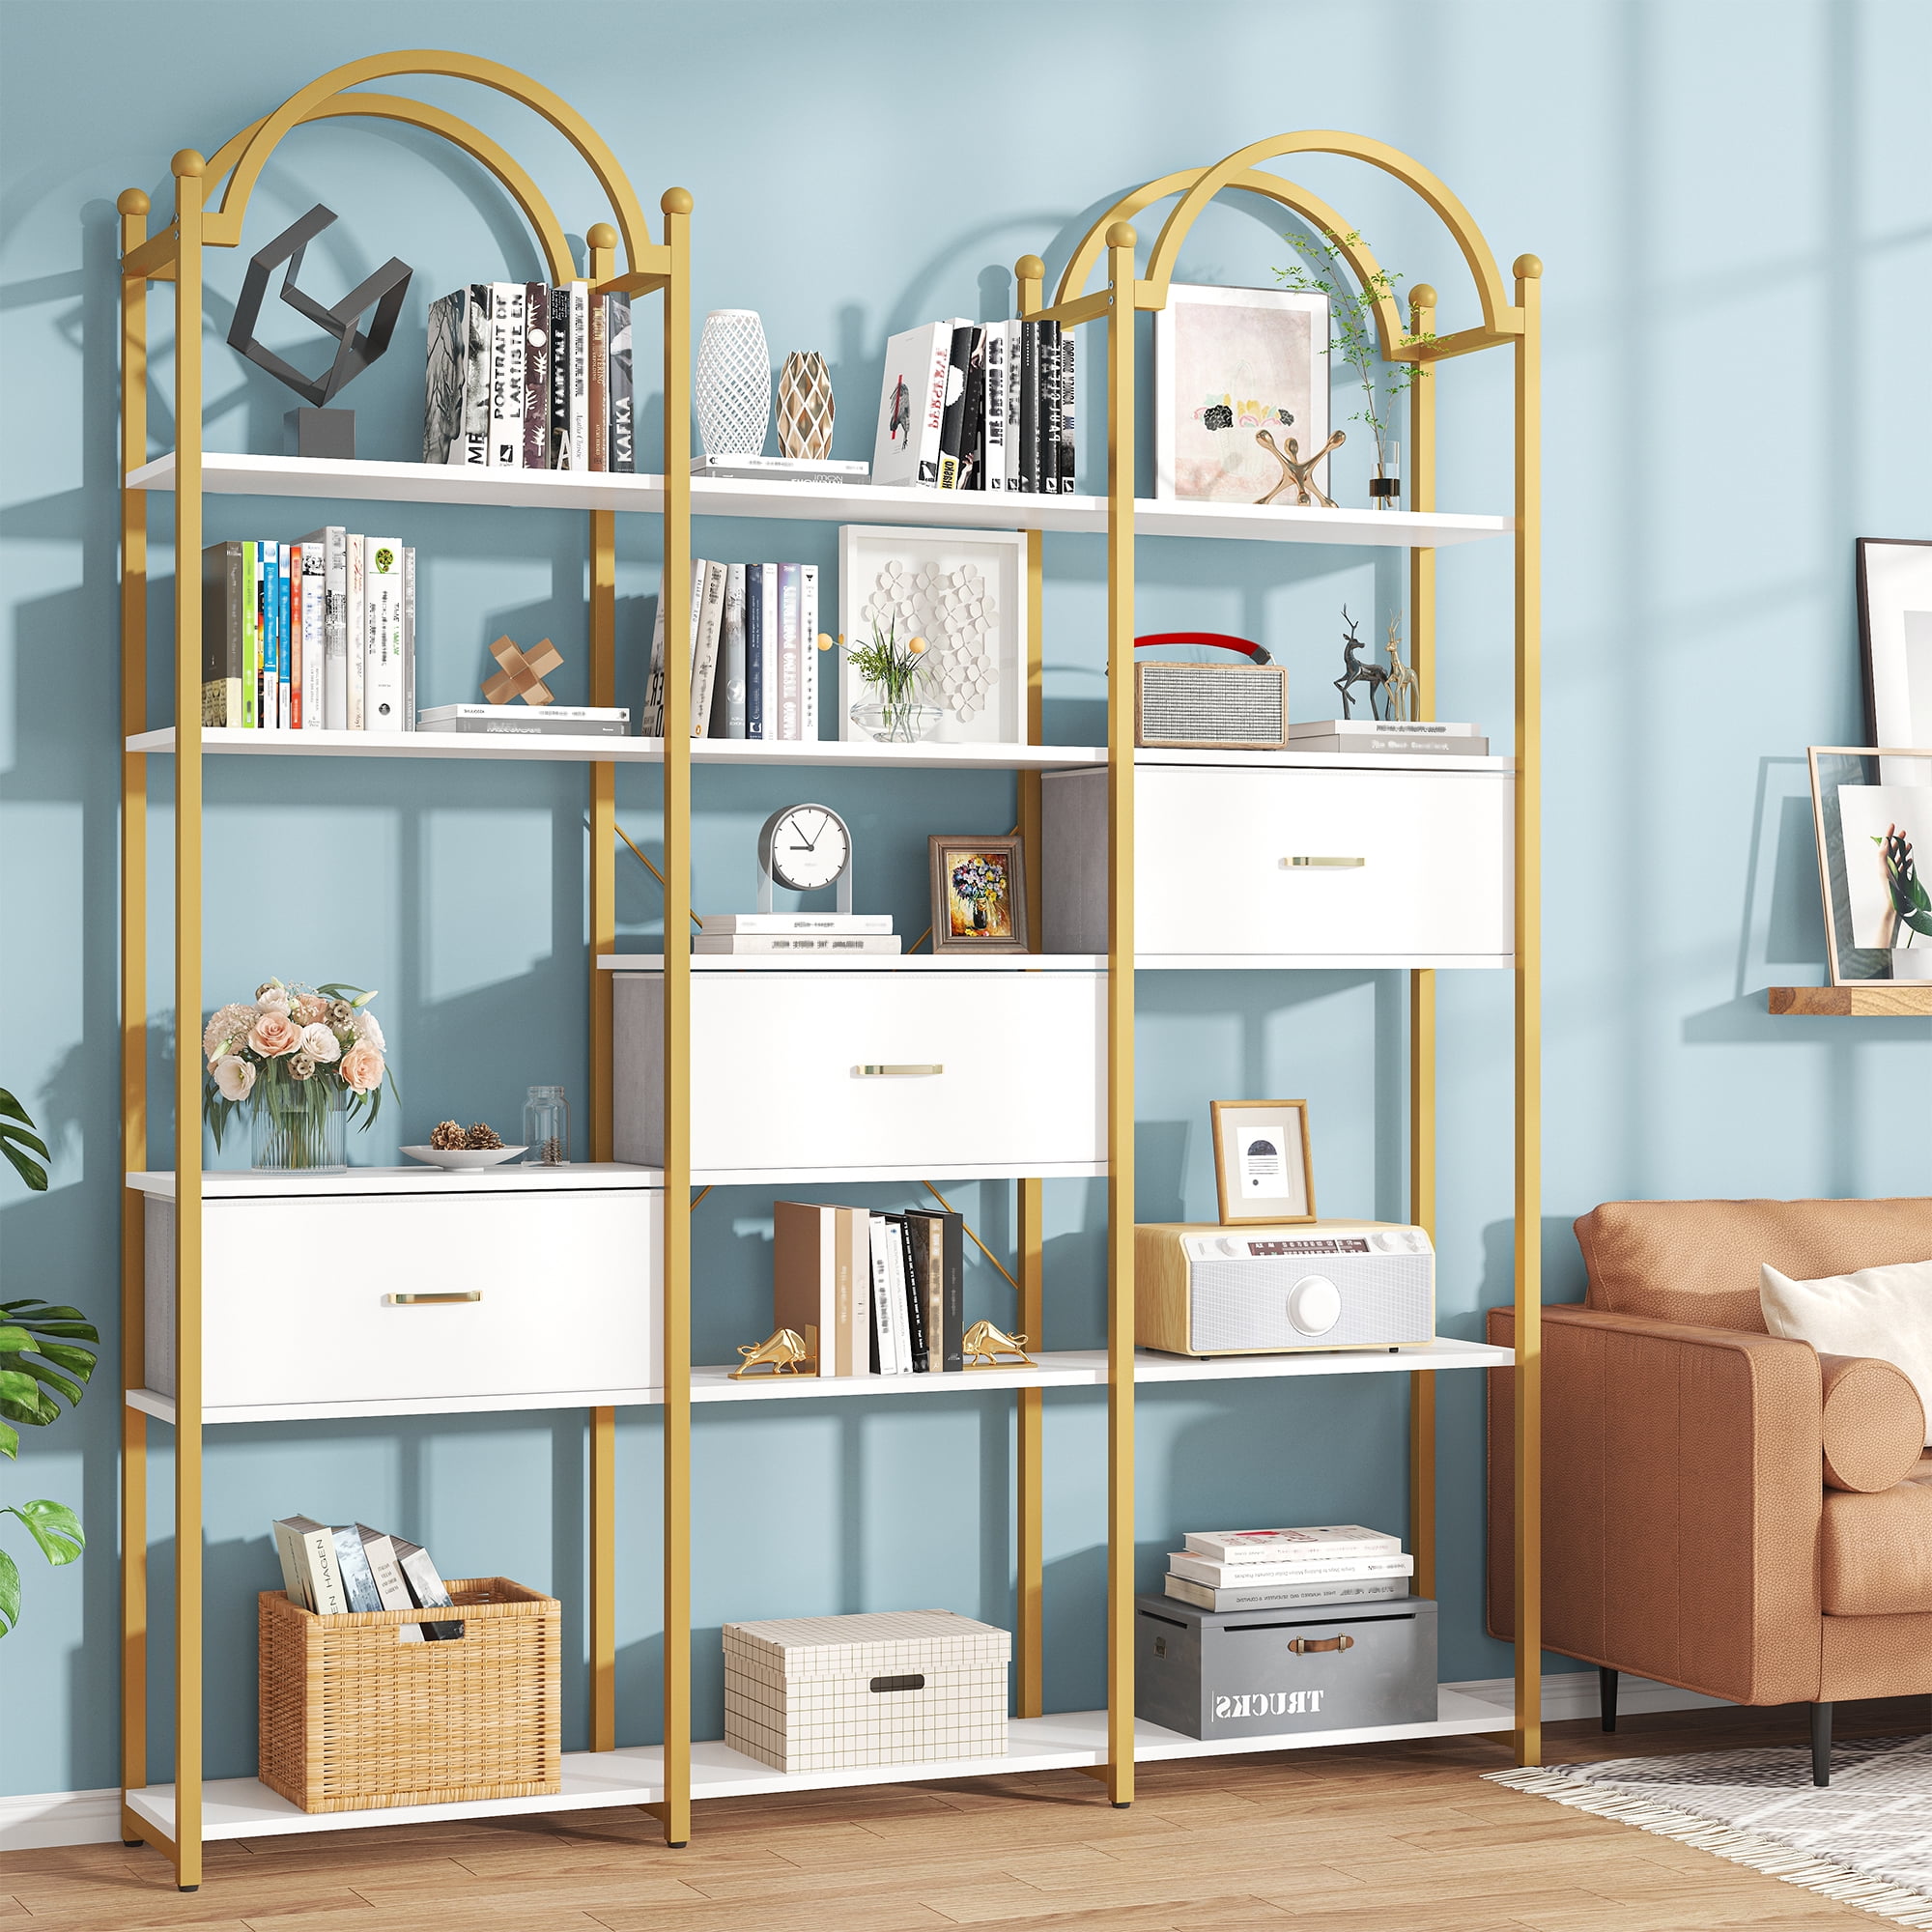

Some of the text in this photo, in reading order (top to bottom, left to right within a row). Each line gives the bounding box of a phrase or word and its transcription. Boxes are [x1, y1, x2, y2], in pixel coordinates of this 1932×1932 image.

[510, 294, 523, 319] EN
[554, 329, 565, 362] TALE
[494, 325, 506, 419] PORTRAIT
[611, 396, 633, 464] KAFKA
[316, 1539, 332, 1589] HAGEN
